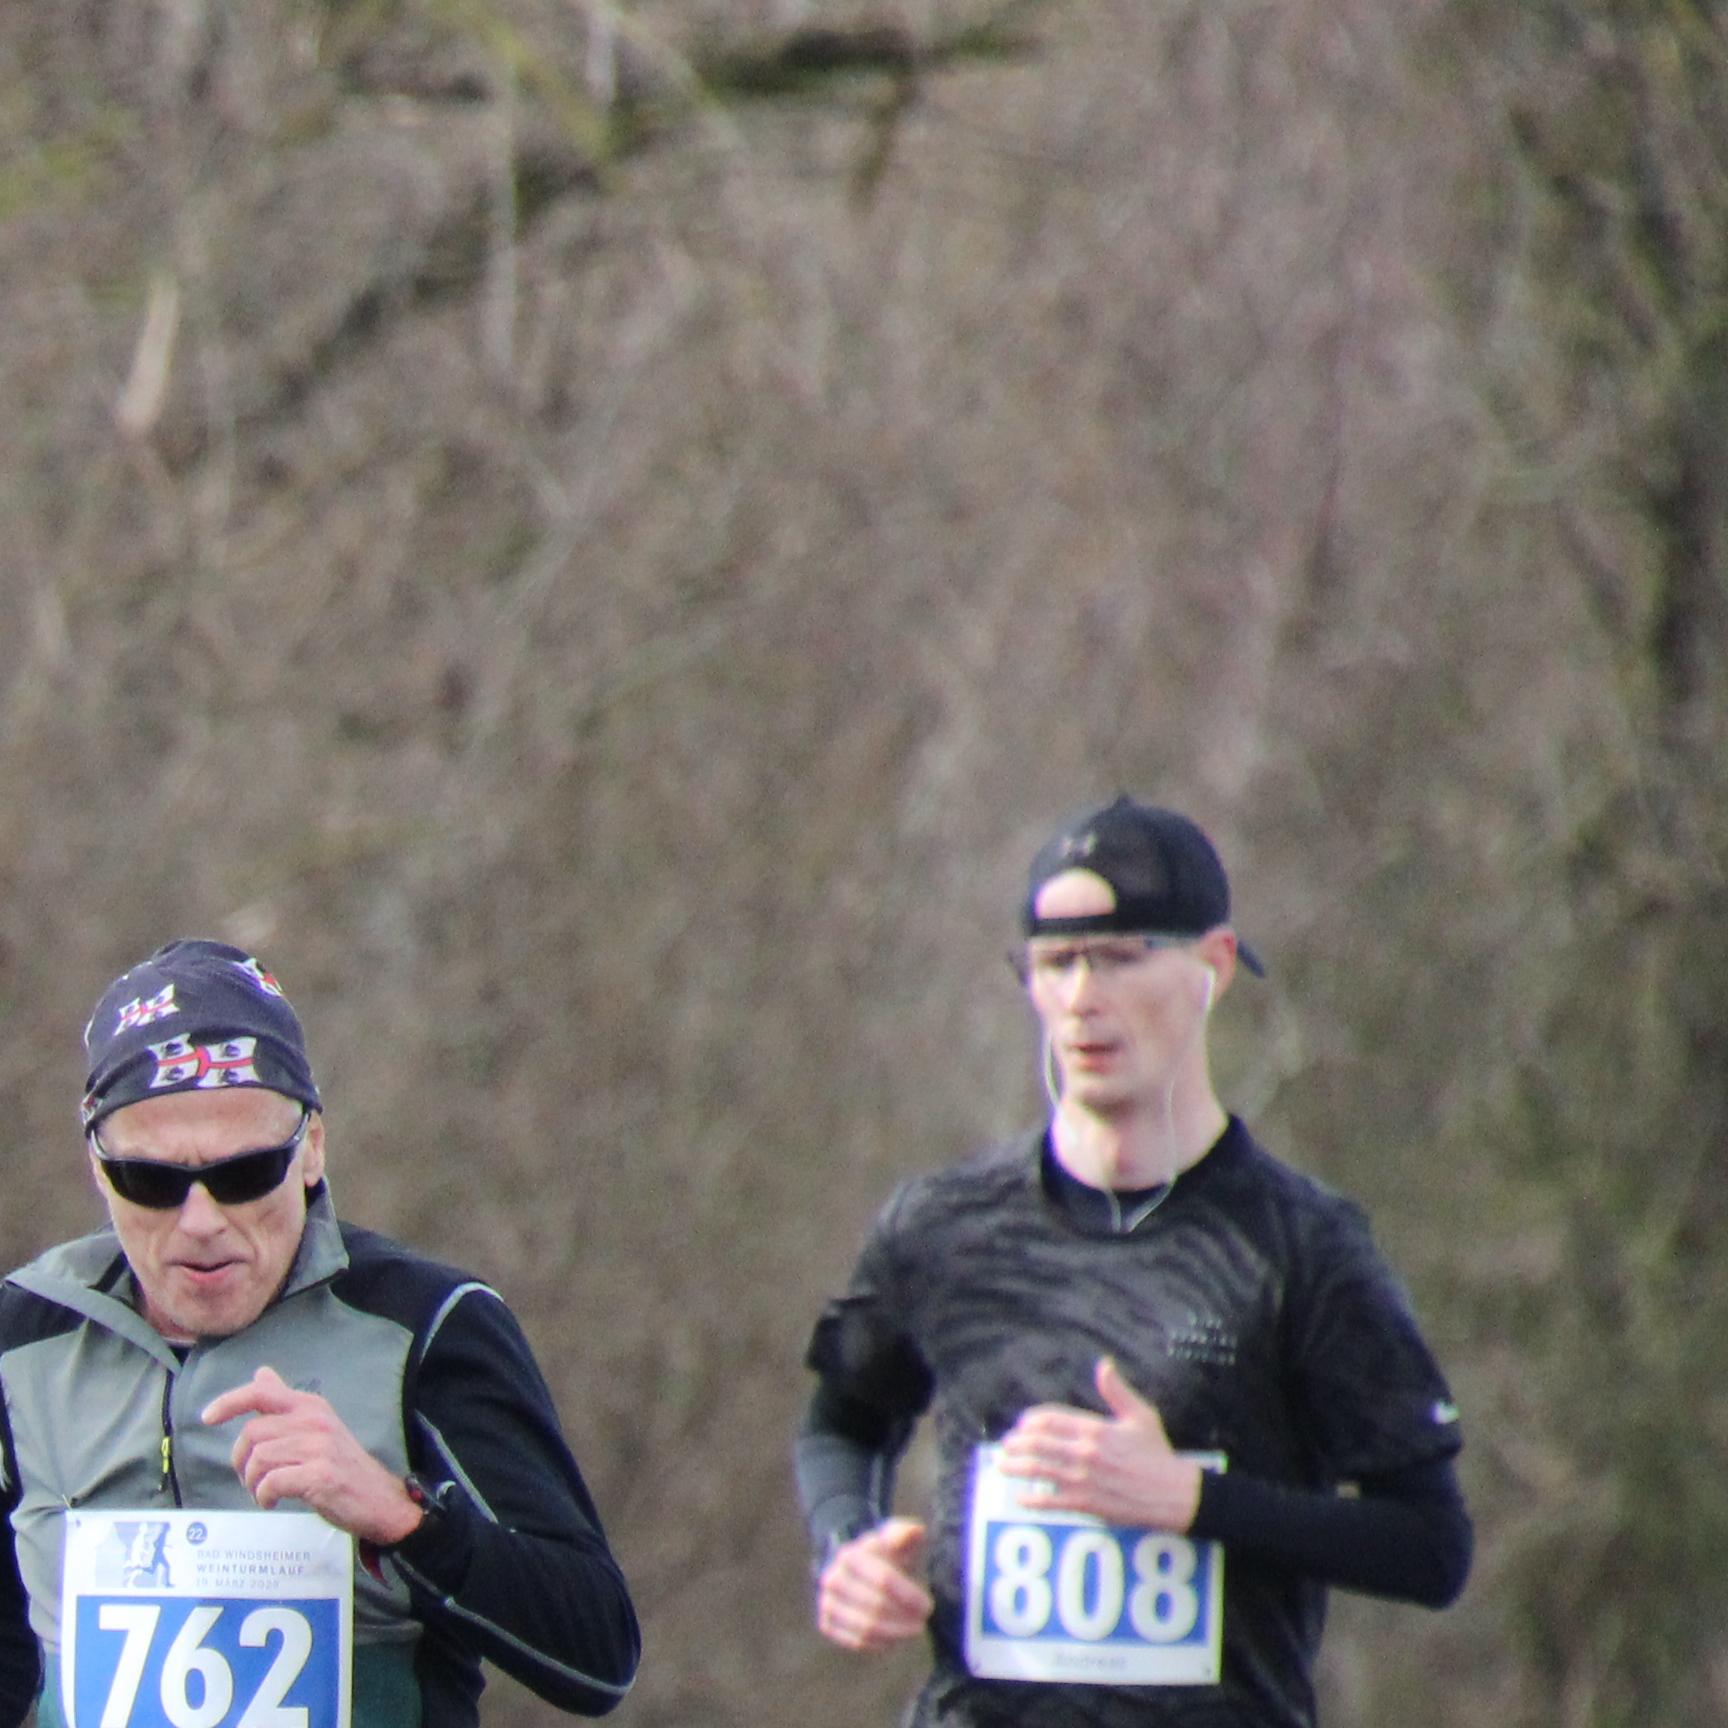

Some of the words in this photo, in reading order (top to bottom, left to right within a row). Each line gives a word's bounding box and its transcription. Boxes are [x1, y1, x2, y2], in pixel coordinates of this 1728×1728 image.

[196, 1550, 220, 1560] BAD
[225, 1550, 312, 1562] WINDSHEIMER
[196, 1564, 305, 1576] WEINTURMLAUF
[991, 1525, 1198, 1644] 808
